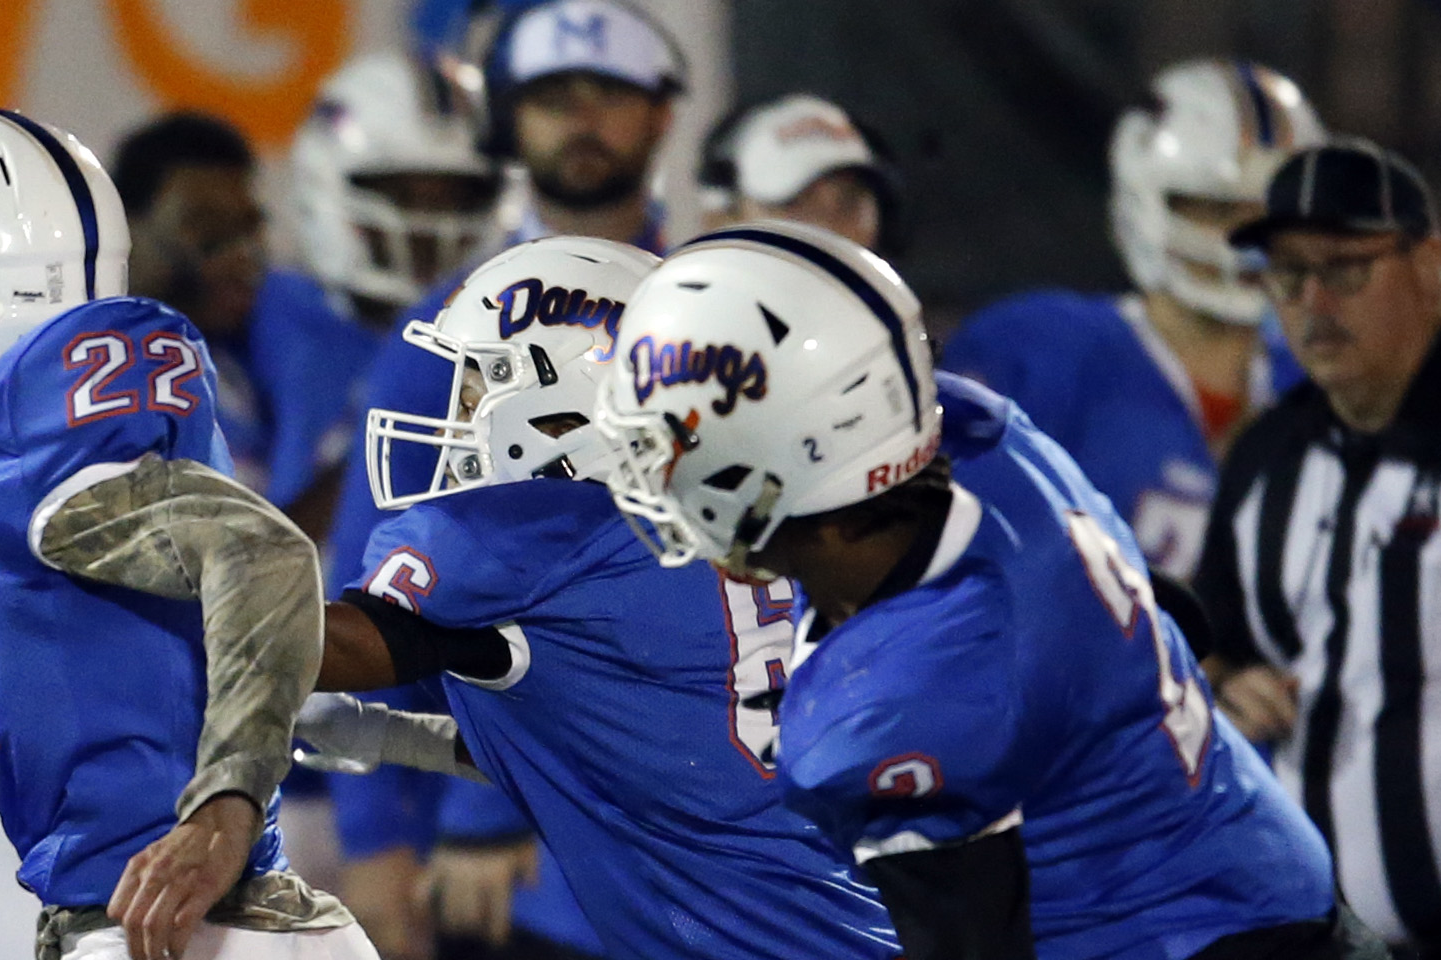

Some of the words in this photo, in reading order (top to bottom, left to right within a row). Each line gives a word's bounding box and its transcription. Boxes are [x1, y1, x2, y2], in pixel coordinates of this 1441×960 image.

[62, 330, 202, 428] 22
[629, 335, 767, 416] Dawgs
[802, 437, 825, 463] 2
[362, 545, 439, 615] 6
